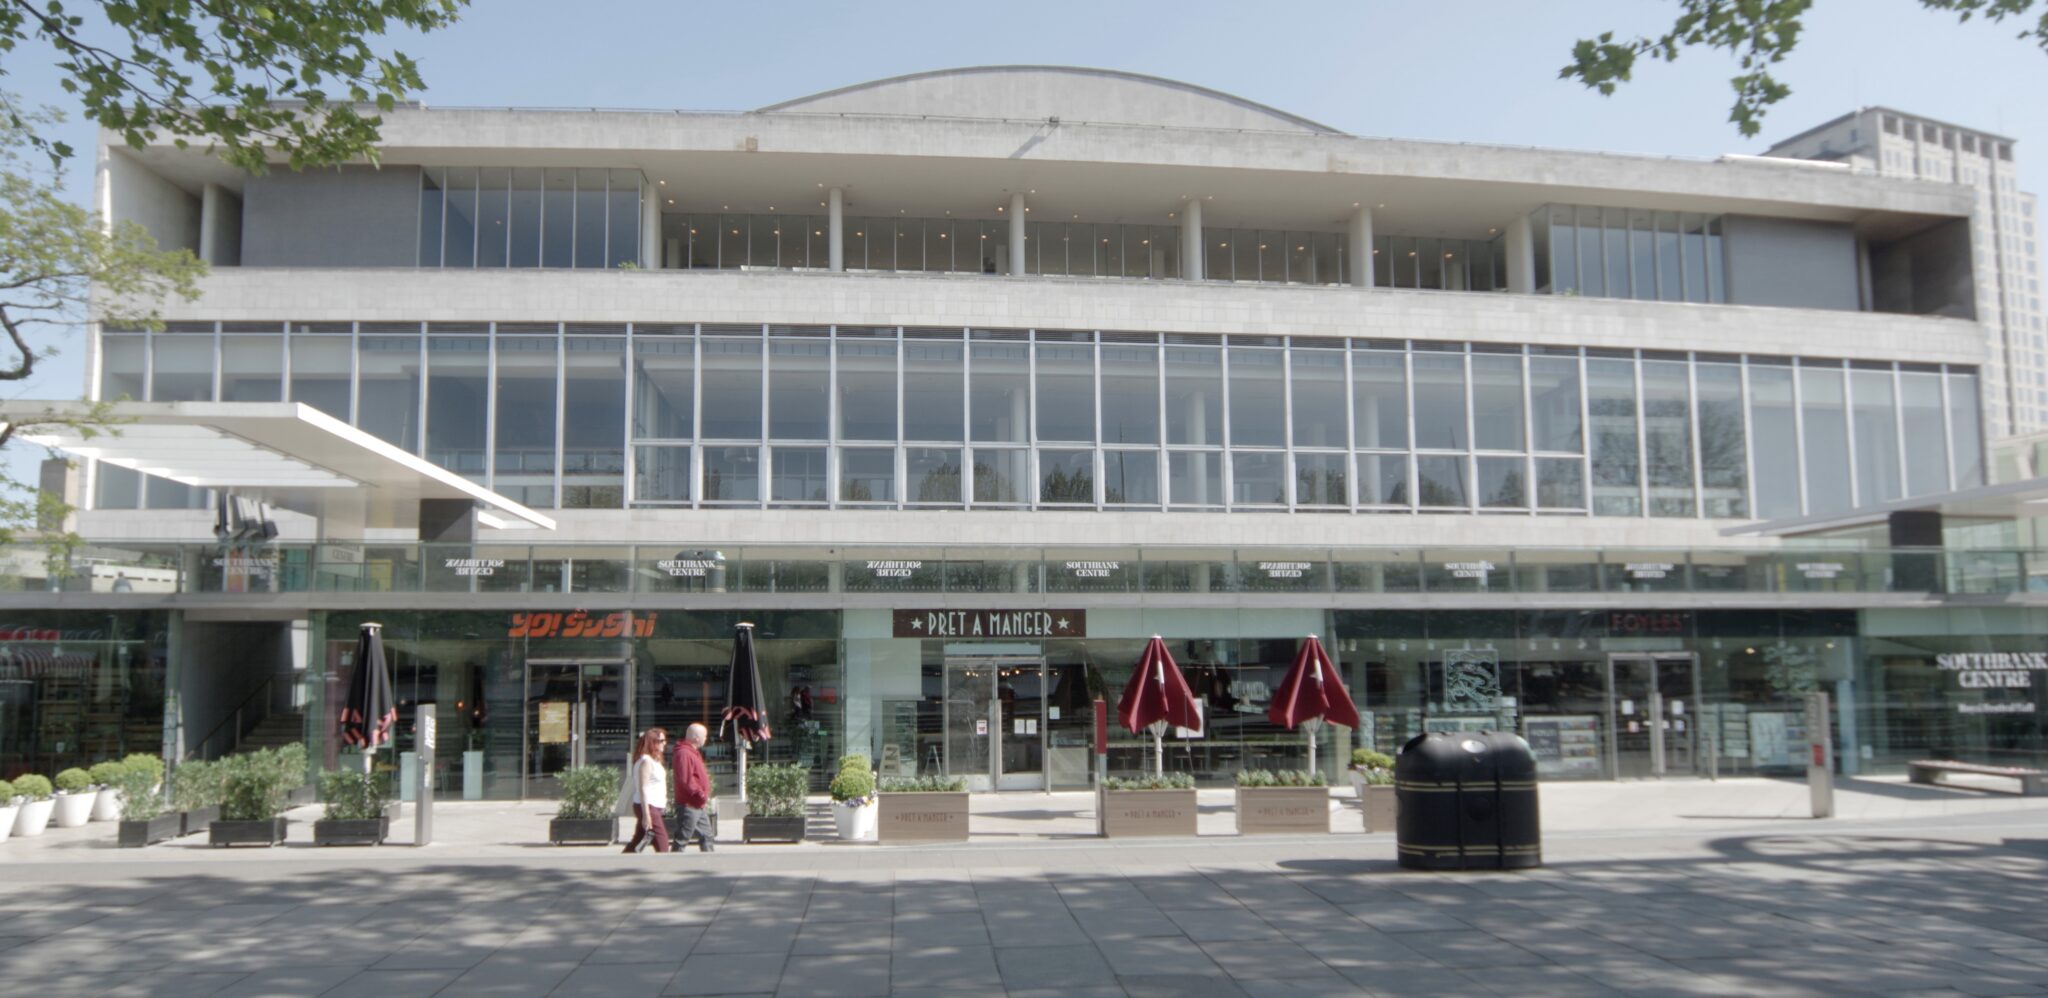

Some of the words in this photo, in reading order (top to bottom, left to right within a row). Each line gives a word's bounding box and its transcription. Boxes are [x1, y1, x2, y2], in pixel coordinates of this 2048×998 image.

[658, 560, 716, 568] SOUTHBANK
[1066, 561, 1119, 569] SOUTHBANK
[669, 568, 706, 576] CENTRE
[1076, 569, 1110, 577] CENTRE
[928, 612, 966, 635] PRET
[972, 612, 983, 635] A
[989, 612, 1053, 635] MANGER
[1936, 652, 2048, 670] SOUTHBANK
[1958, 670, 2031, 688] CENTRE
